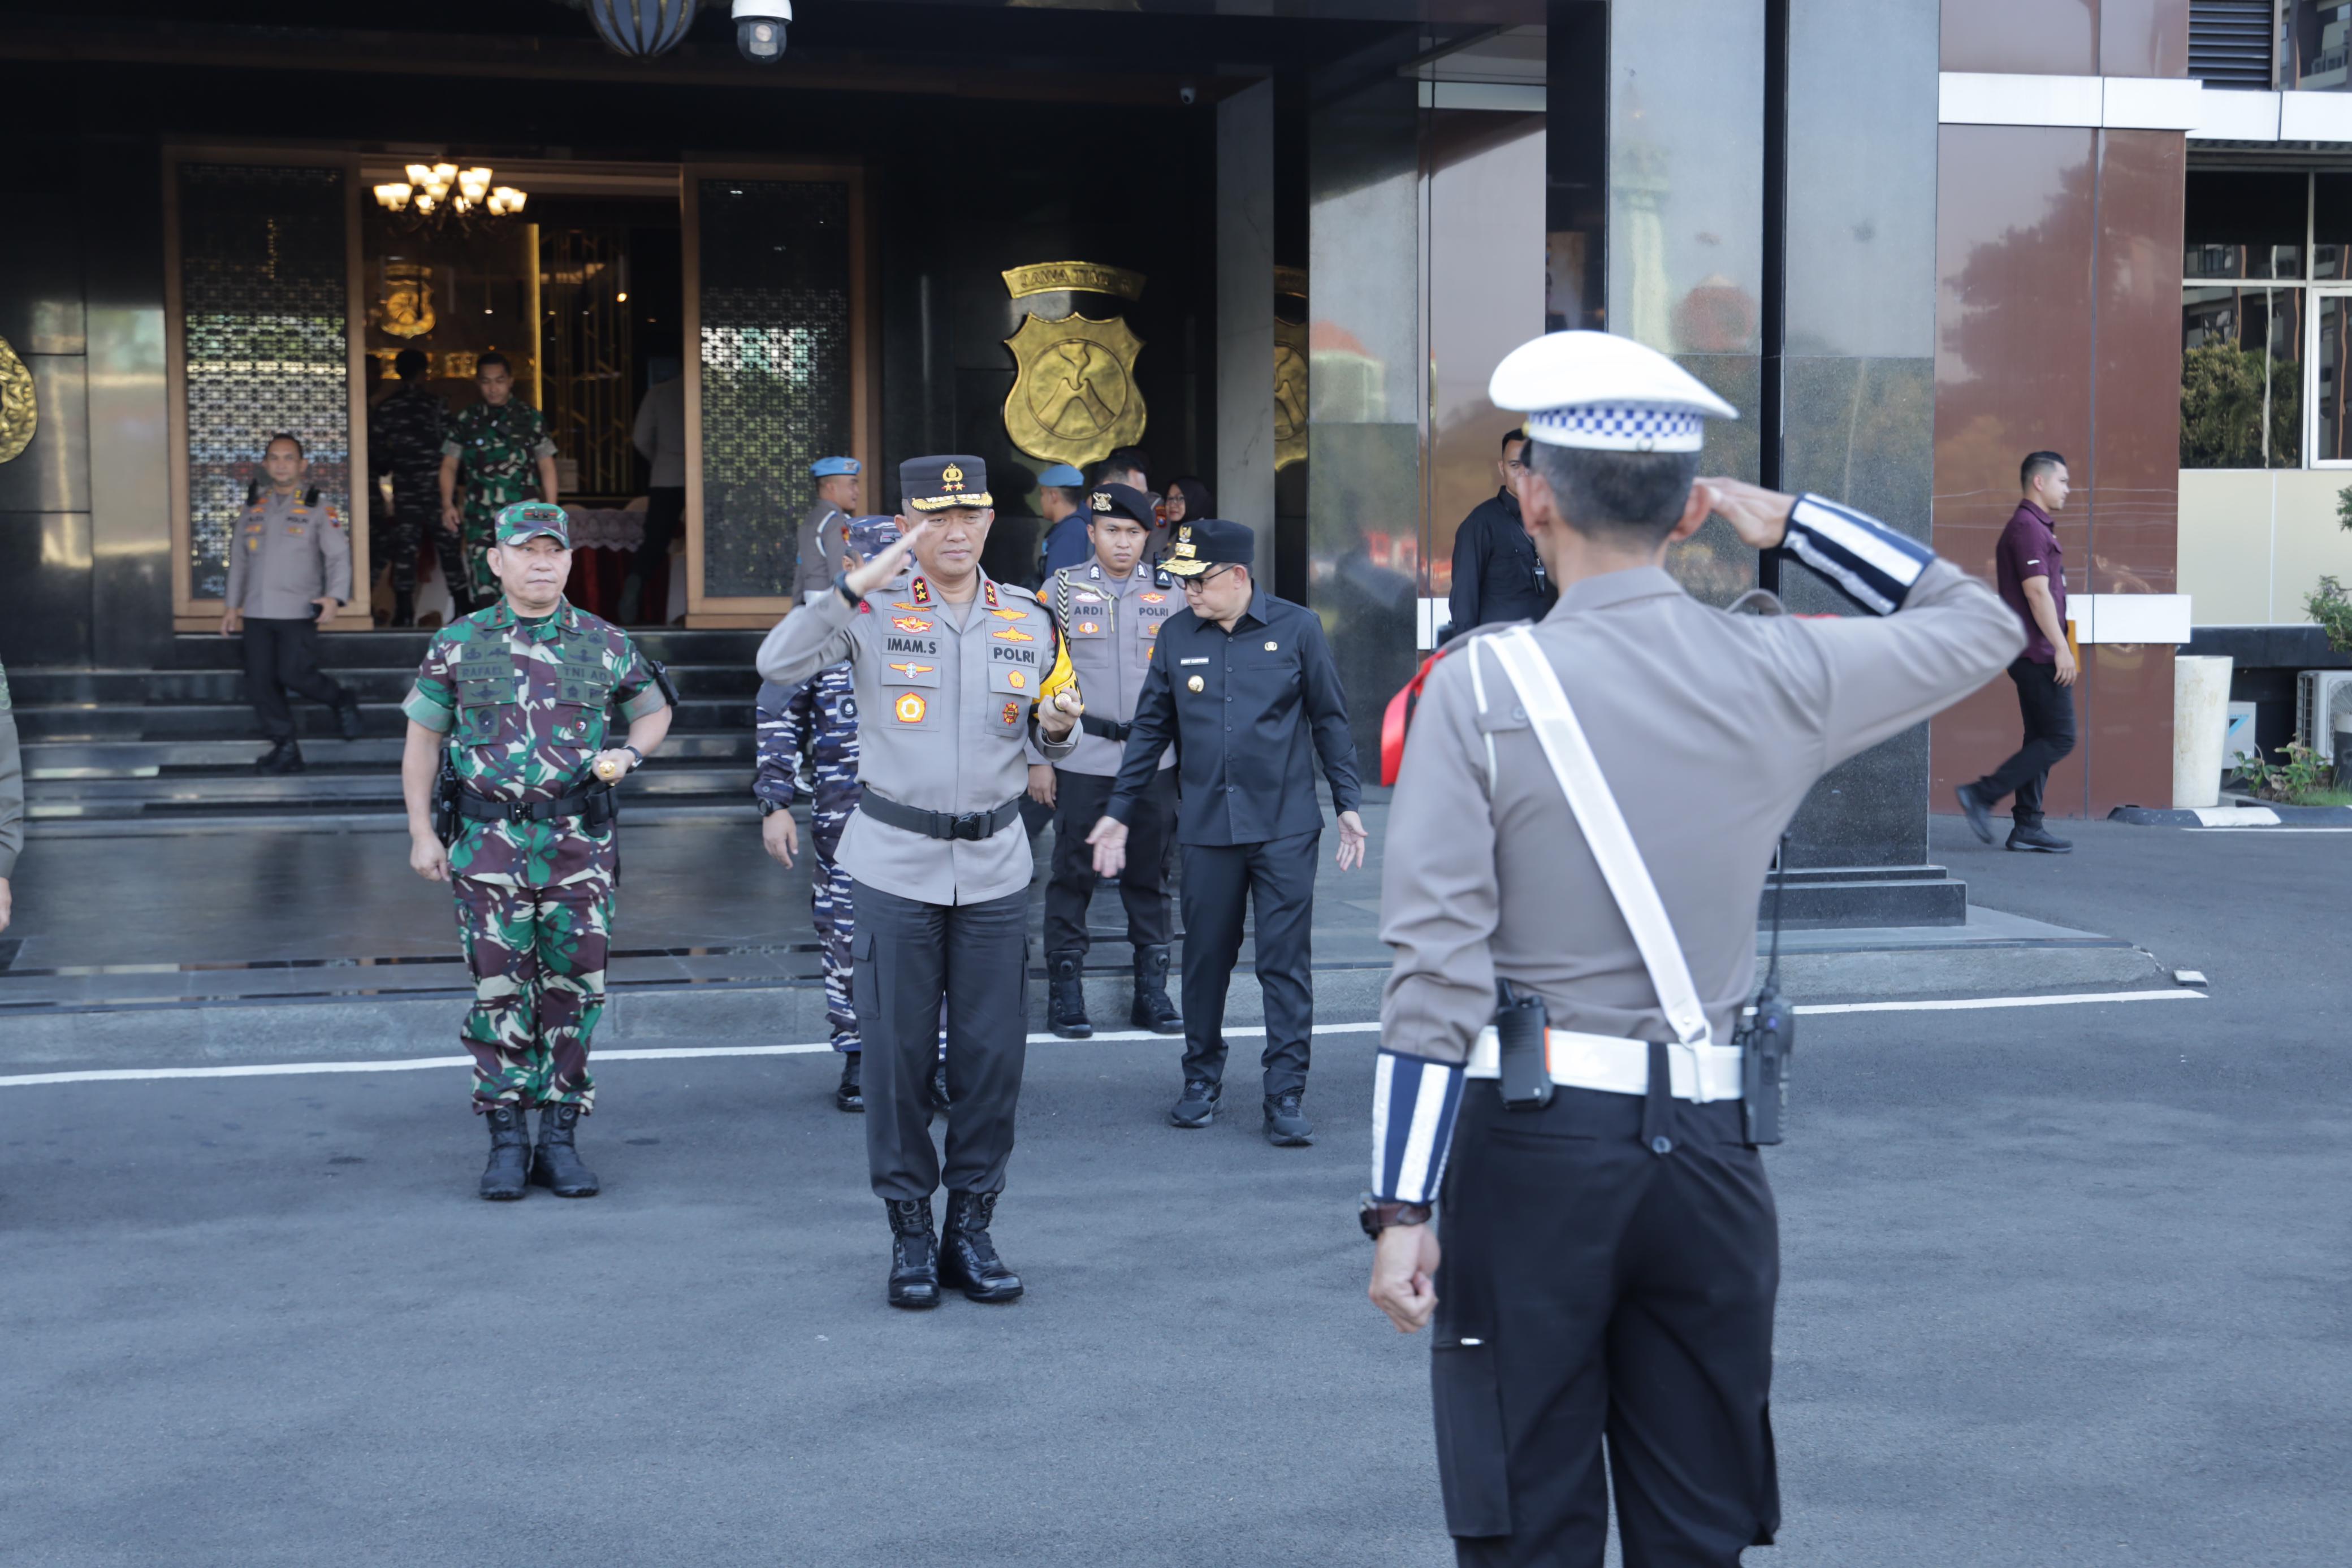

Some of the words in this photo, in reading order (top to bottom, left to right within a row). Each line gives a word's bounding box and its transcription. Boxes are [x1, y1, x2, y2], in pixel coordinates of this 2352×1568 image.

[1021, 268, 1071, 288] JAWA
[1074, 606, 1103, 616] ARDI
[1139, 607, 1169, 617] POLRI
[887, 638, 937, 655] IMAM.S
[993, 647, 1035, 664] POLRI
[461, 665, 505, 678] RAFAEL
[563, 666, 585, 678] TNI
[590, 669, 607, 682] AD
